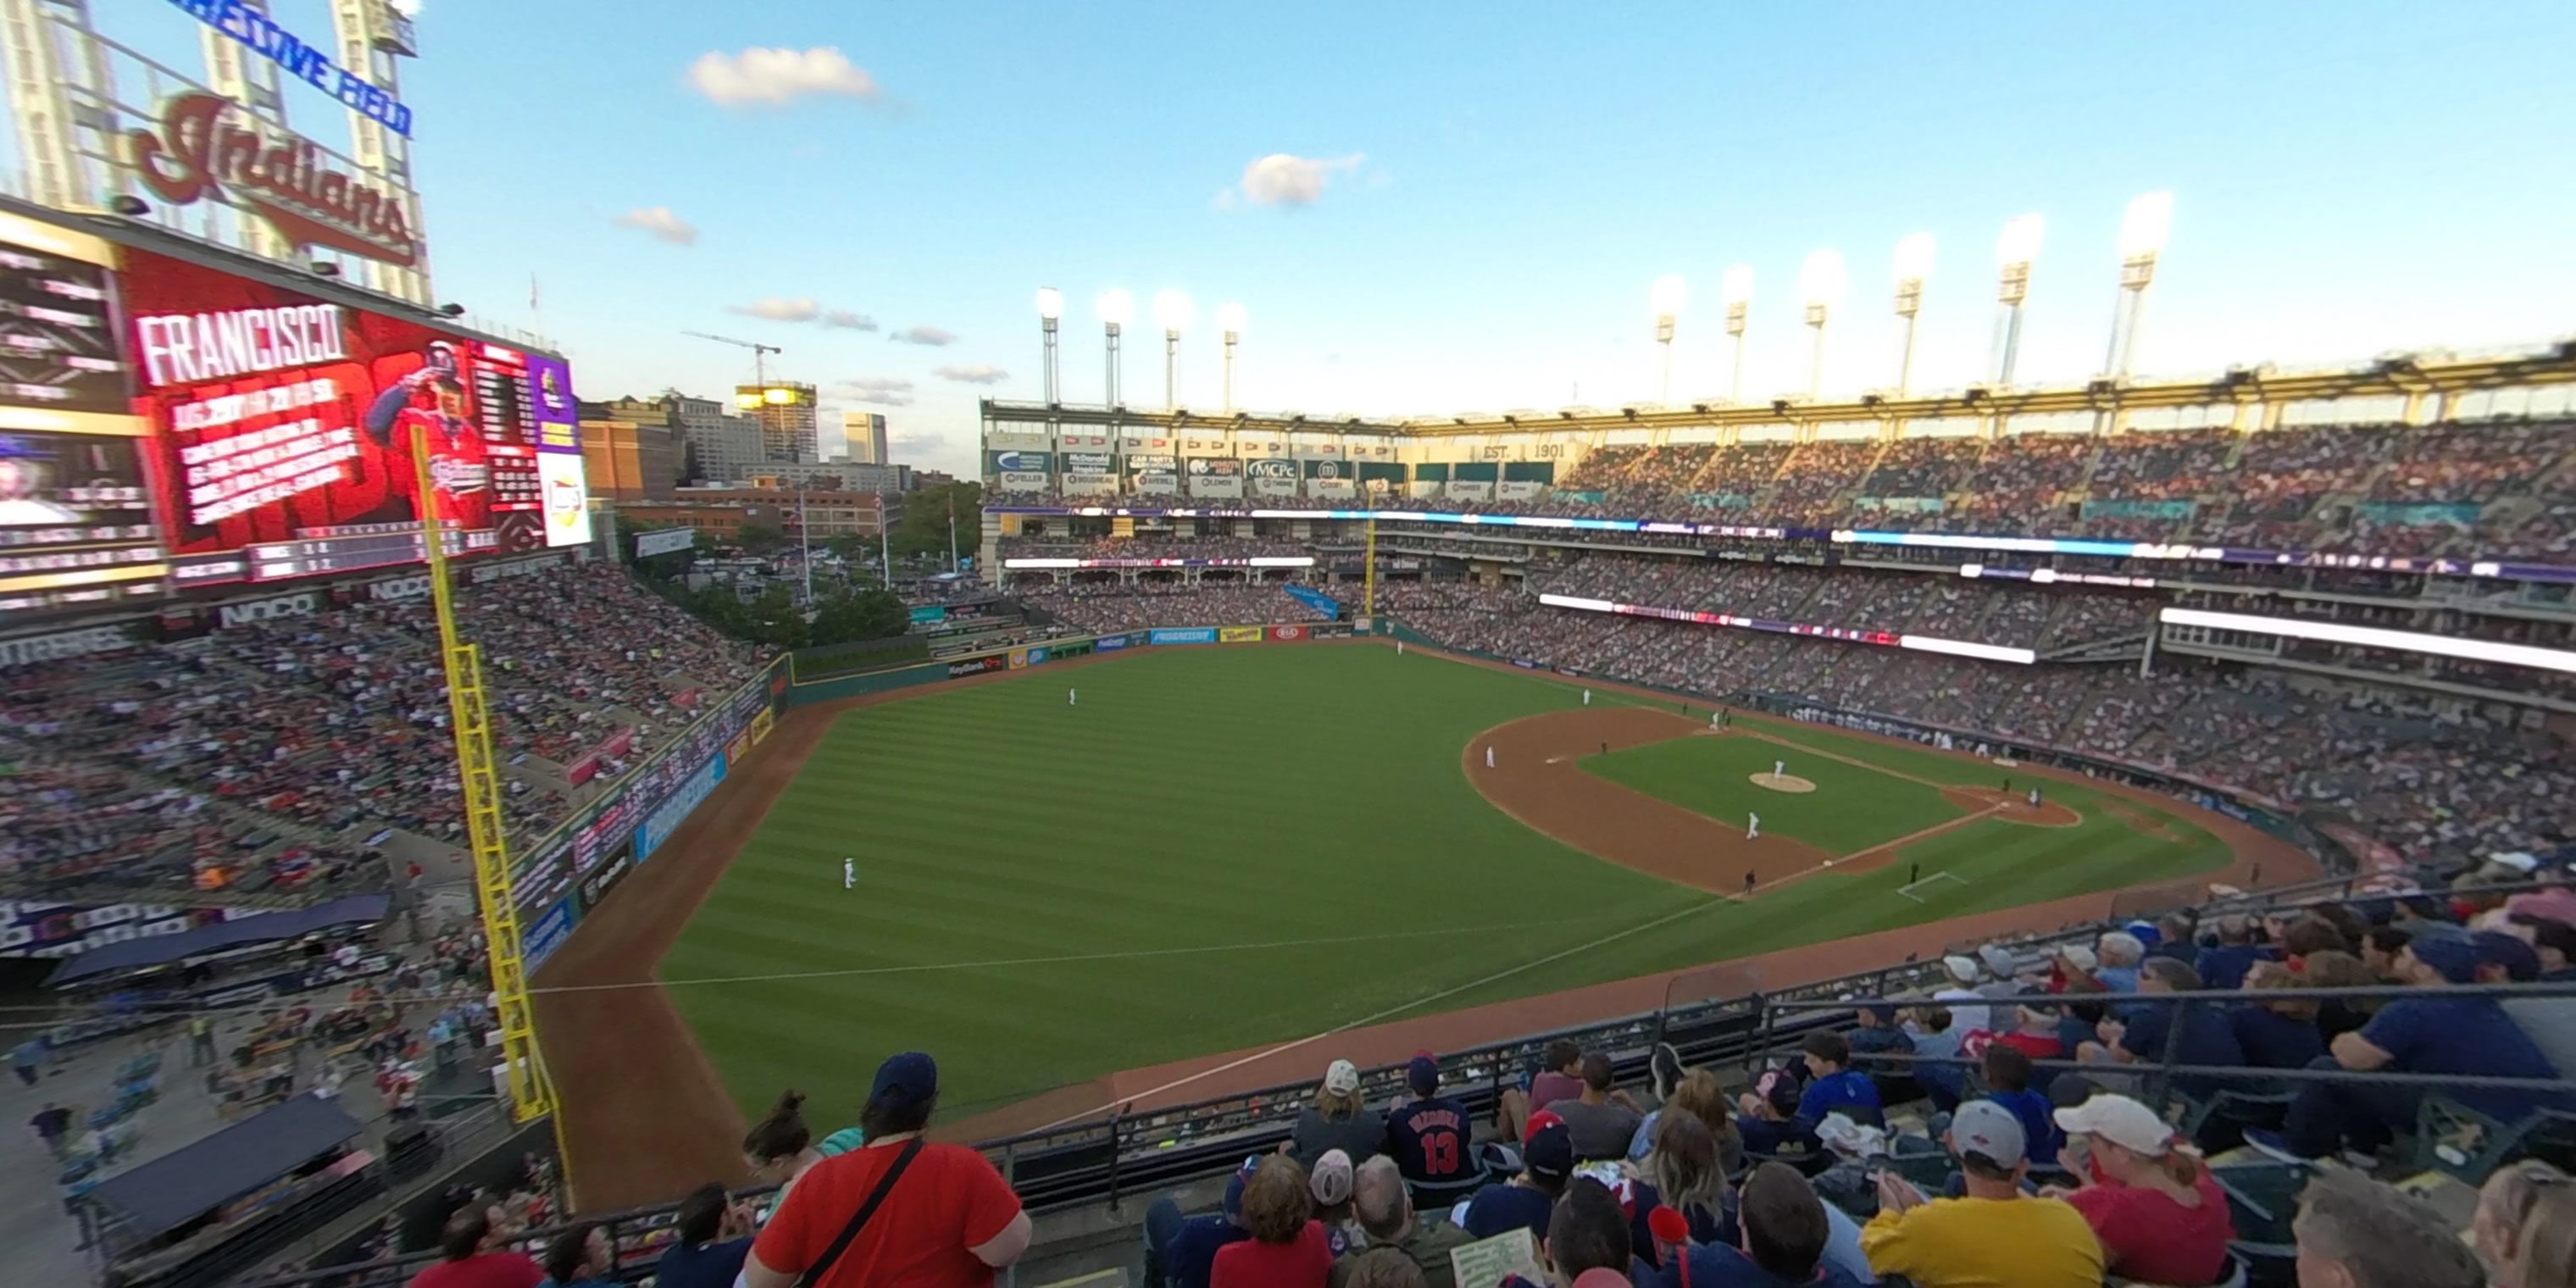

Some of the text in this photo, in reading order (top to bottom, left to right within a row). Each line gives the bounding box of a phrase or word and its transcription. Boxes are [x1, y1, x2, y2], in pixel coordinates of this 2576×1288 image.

[129, 92, 415, 248] Indians
[136, 303, 346, 386] FRANCISCO
[1484, 444, 1564, 458] EST. 1901
[1255, 464, 1295, 477] MCPc
[369, 575, 435, 600] NOCO
[219, 594, 318, 629] NOCO
[1421, 1131, 1458, 1174] 13
